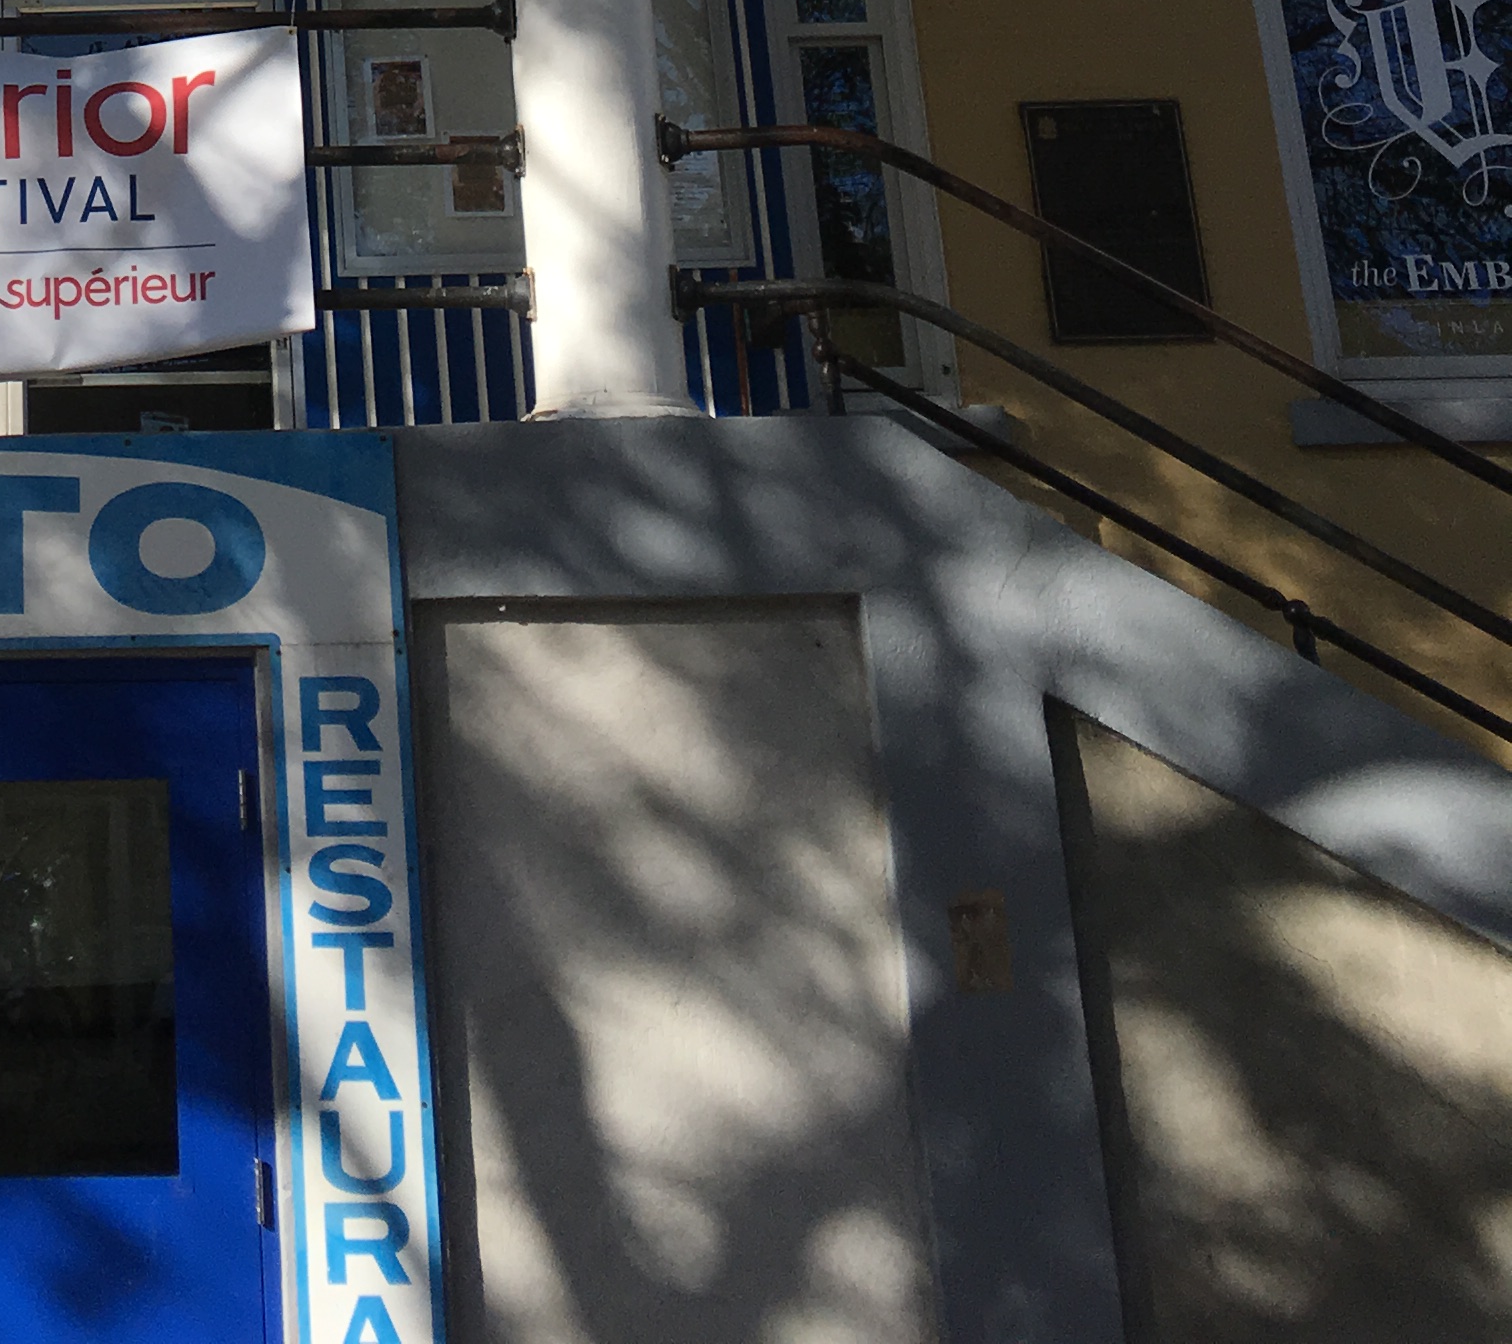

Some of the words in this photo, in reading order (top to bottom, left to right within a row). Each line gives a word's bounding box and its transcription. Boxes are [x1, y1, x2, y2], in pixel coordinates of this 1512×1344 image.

[5, 265, 217, 320] supérieur
[1351, 260, 1398, 288] the
[1402, 253, 1512, 292] EMB
[298, 675, 413, 1344] RESTAURA
